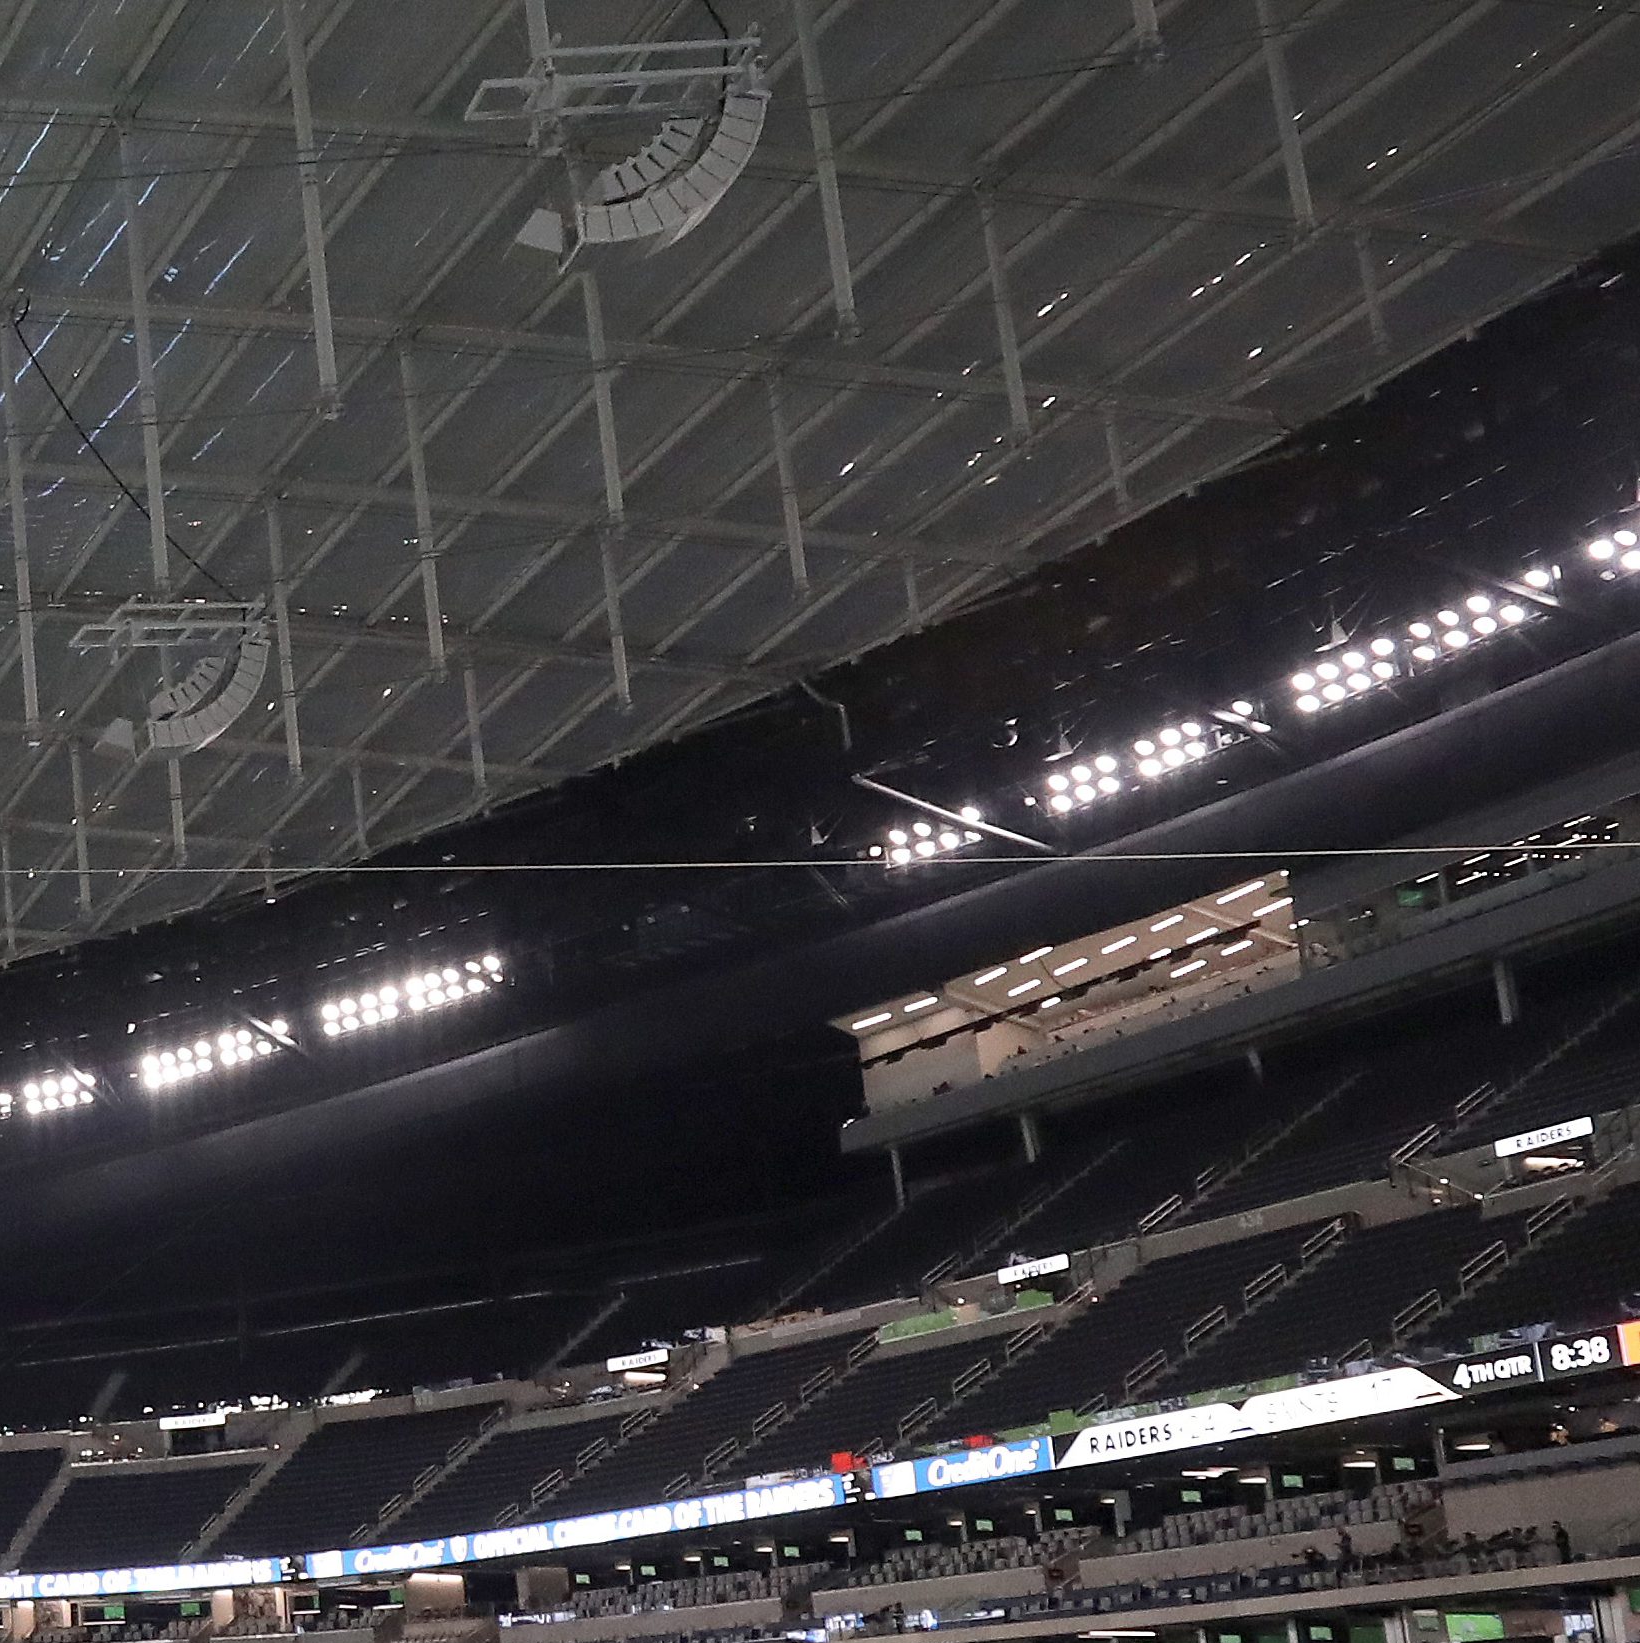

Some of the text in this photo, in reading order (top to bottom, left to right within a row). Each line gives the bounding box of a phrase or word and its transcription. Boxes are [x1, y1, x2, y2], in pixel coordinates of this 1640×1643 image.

[1515, 1125, 1572, 1149] RAIDERS
[1550, 1335, 1611, 1370] 8:38
[1089, 1422, 1173, 1455] RAIDERS
[473, 1525, 555, 1559] OFFICIAL
[618, 1503, 673, 1537] CARD
[674, 1500, 702, 1529] OF
[38, 1571, 100, 1597] CARD
[101, 1569, 132, 1594] OF
